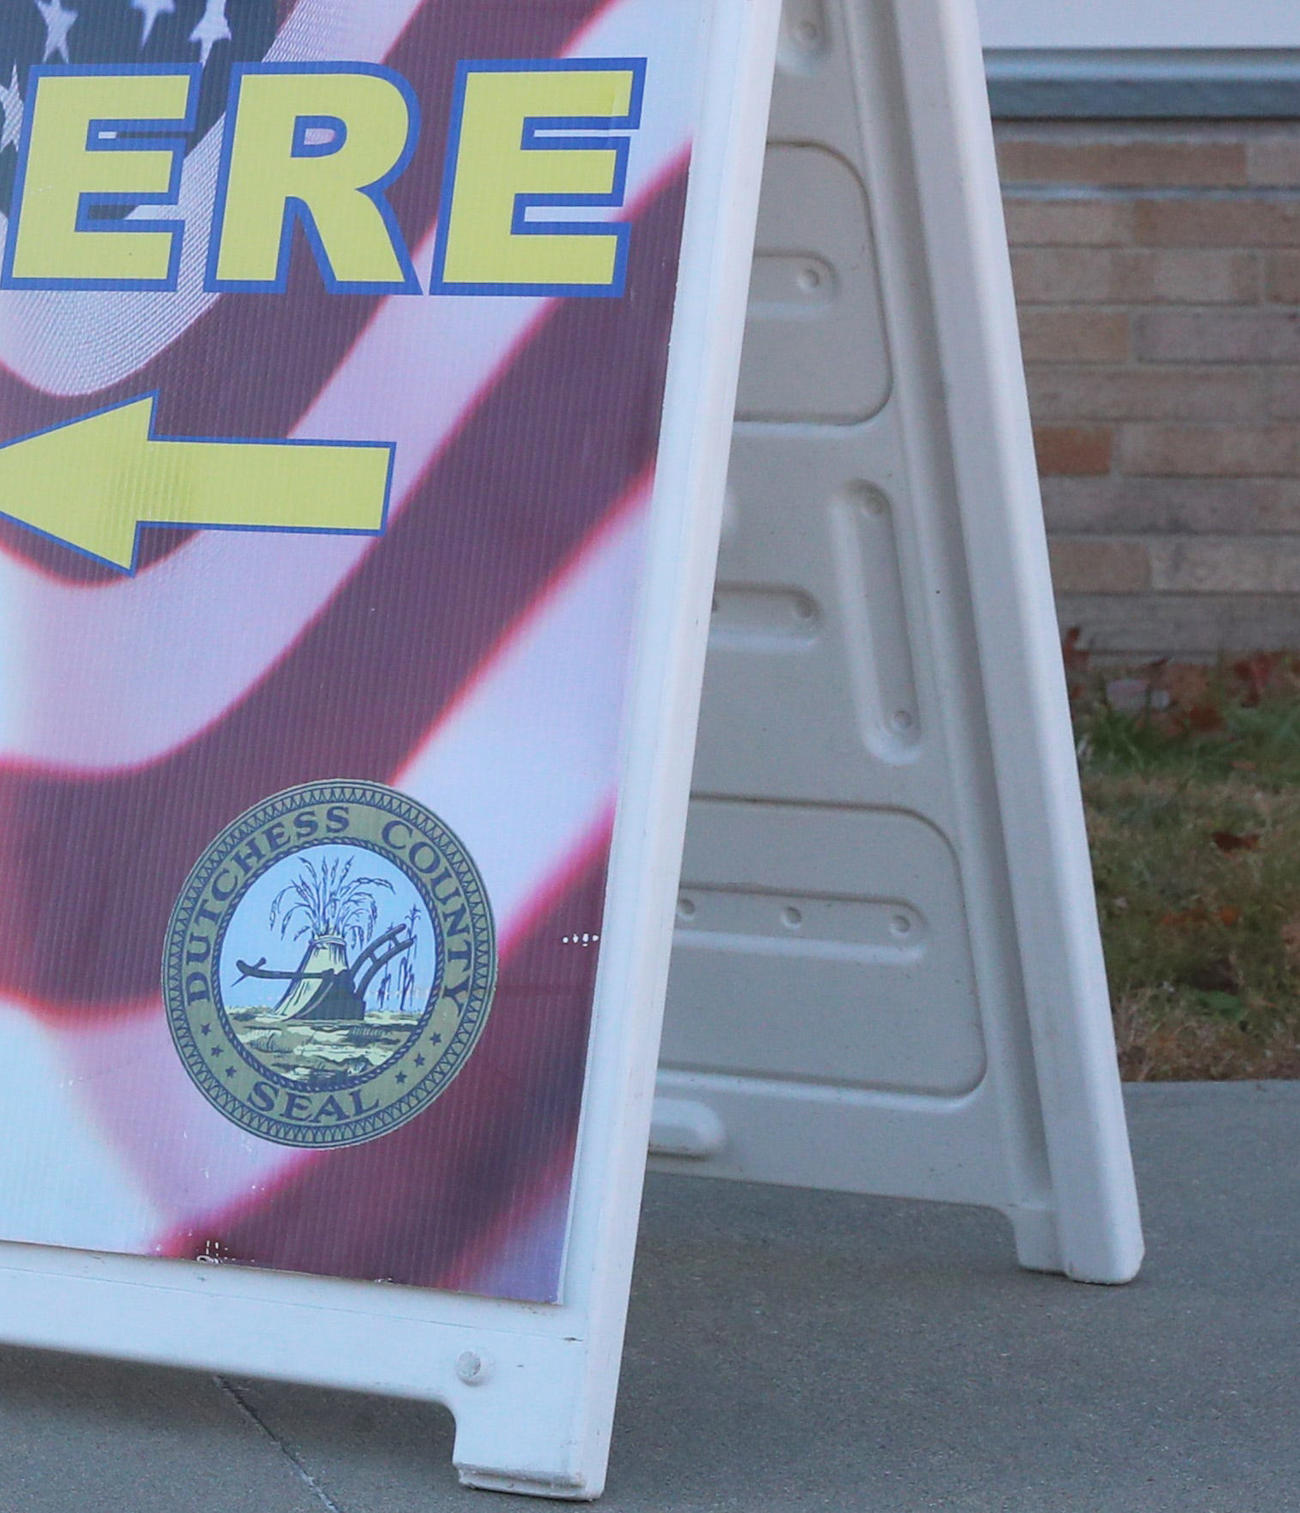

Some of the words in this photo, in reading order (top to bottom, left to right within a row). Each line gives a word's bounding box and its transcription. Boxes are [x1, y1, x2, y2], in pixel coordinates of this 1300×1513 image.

[186, 806, 350, 1007] DUTCHESS
[381, 819, 473, 1016] COUNTY
[246, 1080, 380, 1124] SEAL
